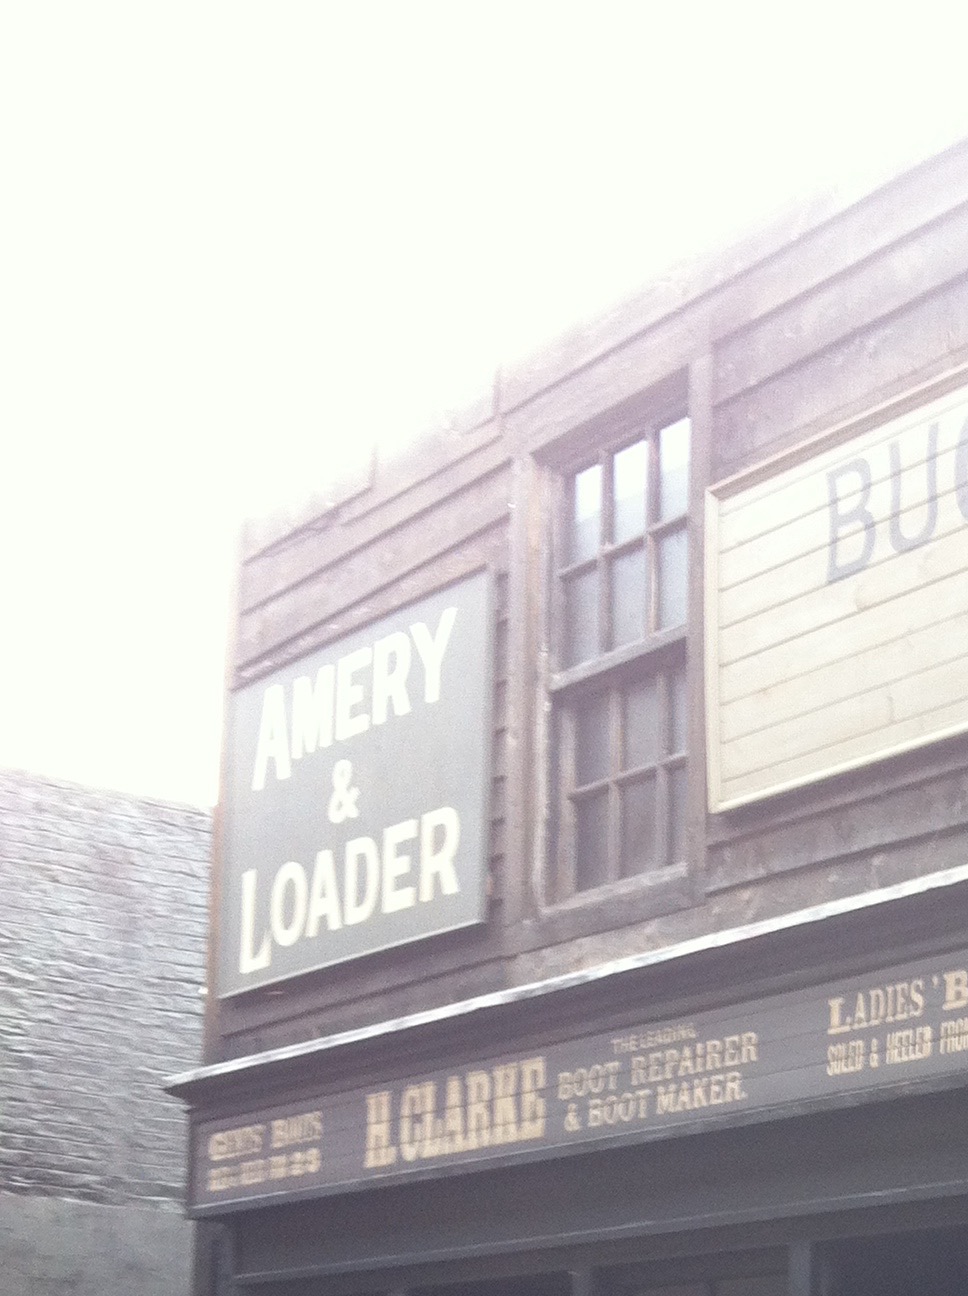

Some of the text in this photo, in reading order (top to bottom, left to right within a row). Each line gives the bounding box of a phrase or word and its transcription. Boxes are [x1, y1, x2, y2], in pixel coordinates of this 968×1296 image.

[252, 607, 457, 791] AMERY
[328, 759, 360, 824] &
[239, 807, 460, 974] LOADER
[557, 1031, 758, 1101] BOOT REPAIRER
[564, 1103, 581, 1132] &
[587, 1089, 651, 1128] BOOT
